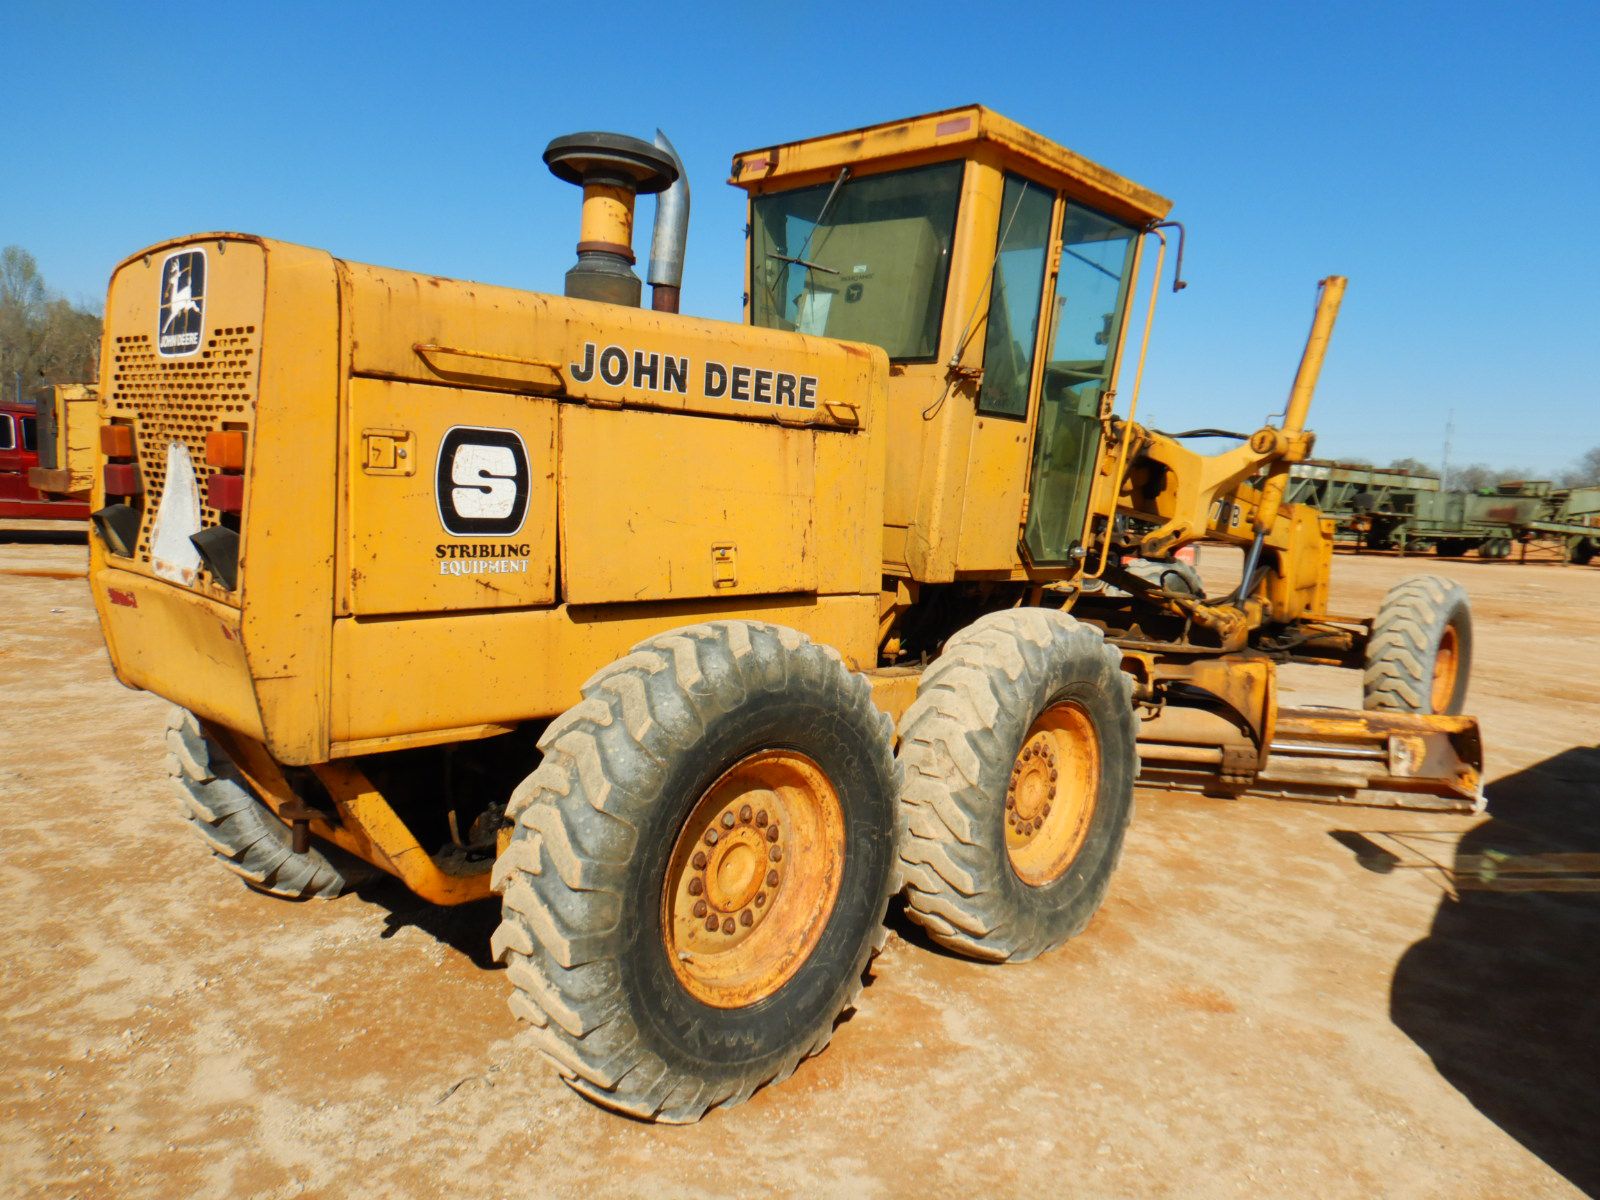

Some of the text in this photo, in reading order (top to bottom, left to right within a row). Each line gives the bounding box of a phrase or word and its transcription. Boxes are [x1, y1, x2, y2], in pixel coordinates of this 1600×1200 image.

[160, 332, 199, 348] JOHN DEERE
[570, 342, 818, 410] JOHN DEERE
[452, 444, 517, 519] S
[436, 544, 530, 558] STRIBLING
[440, 560, 528, 576] EQUIPMENT
